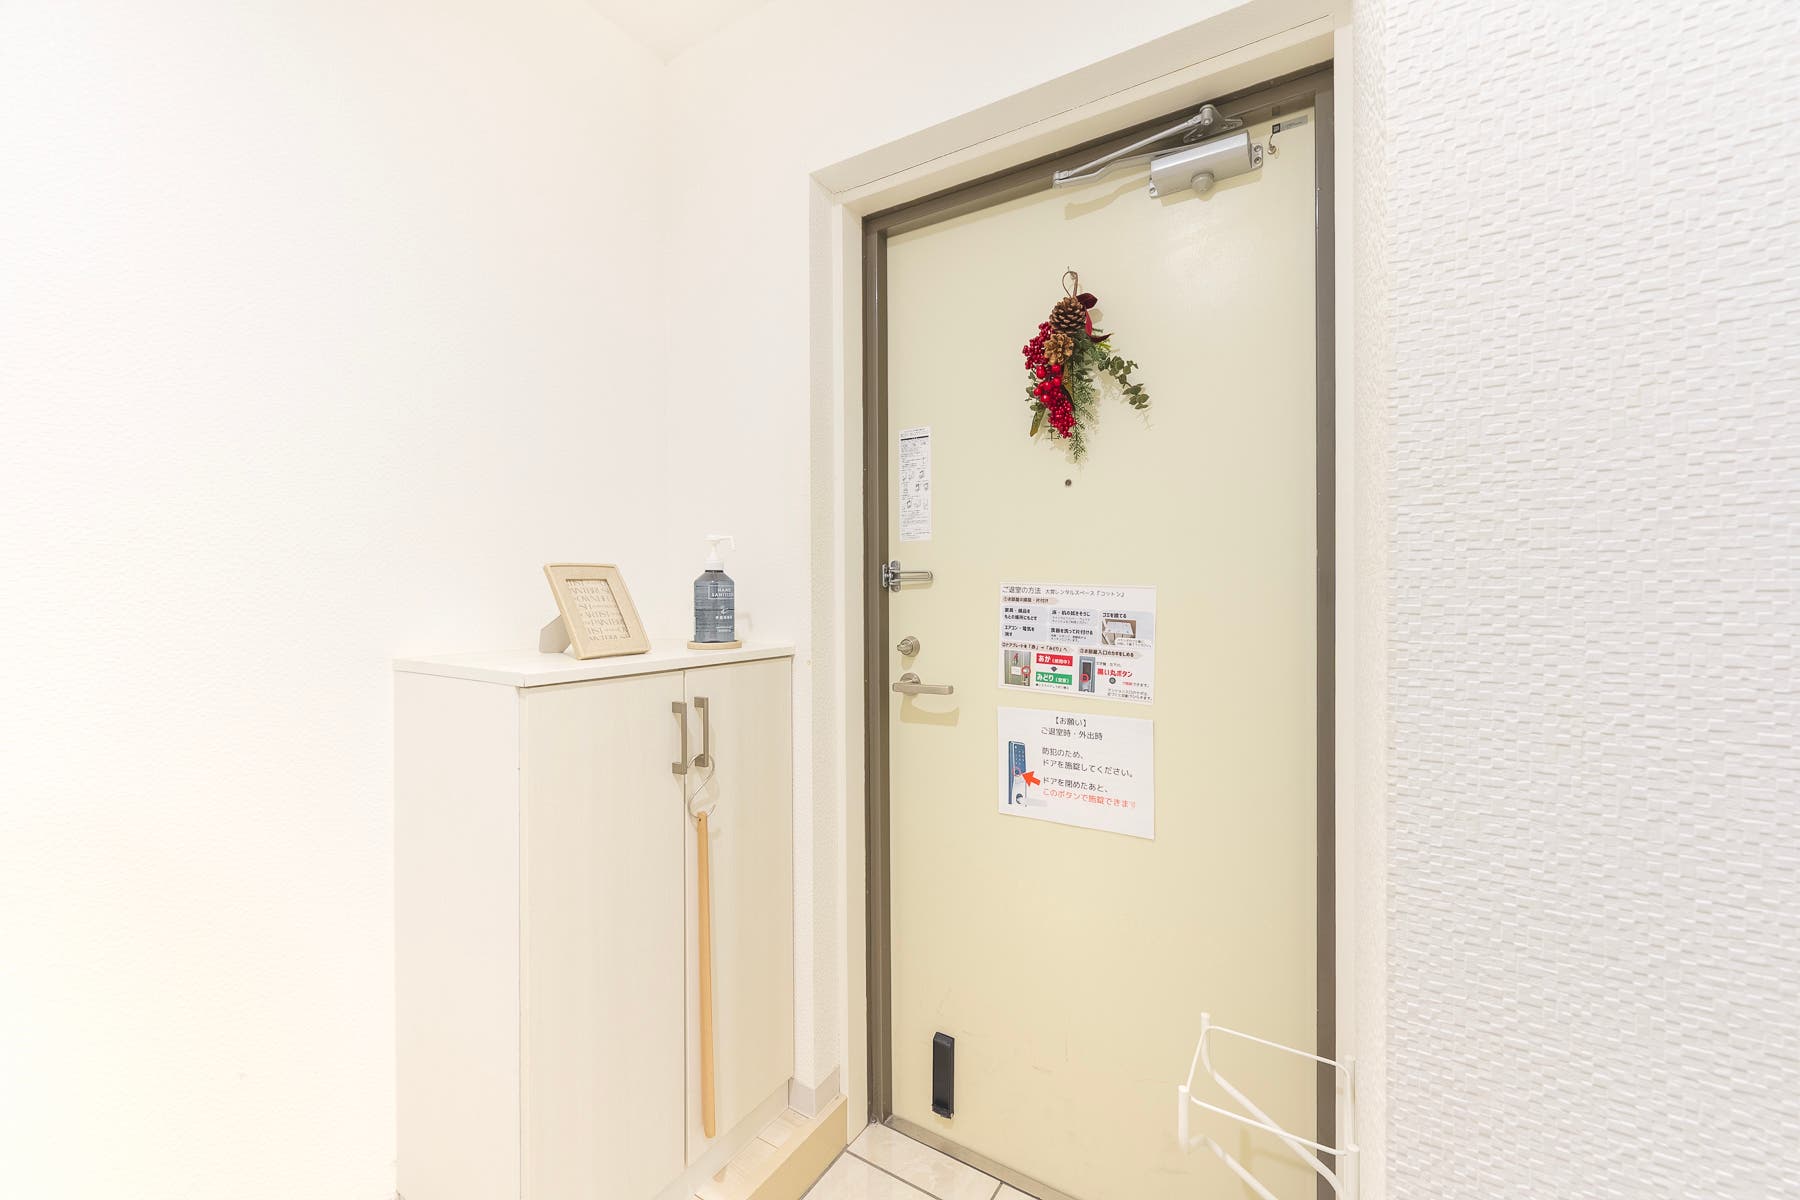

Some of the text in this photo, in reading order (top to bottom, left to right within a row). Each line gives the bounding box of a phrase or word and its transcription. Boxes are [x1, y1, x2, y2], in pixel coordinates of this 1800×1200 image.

[1002, 586, 1042, 595] ご退室の方法
[1097, 668, 1133, 678] 黒い丸ボタン
[1055, 716, 1087, 727] 【お願い】
[1040, 727, 1103, 741] ご退室時・外出時
[1042, 747, 1084, 759] 防犯のため、
[1042, 759, 1133, 778] ドアを施錠してください。
[1042, 776, 1109, 793] ドアを閉めたあと、
